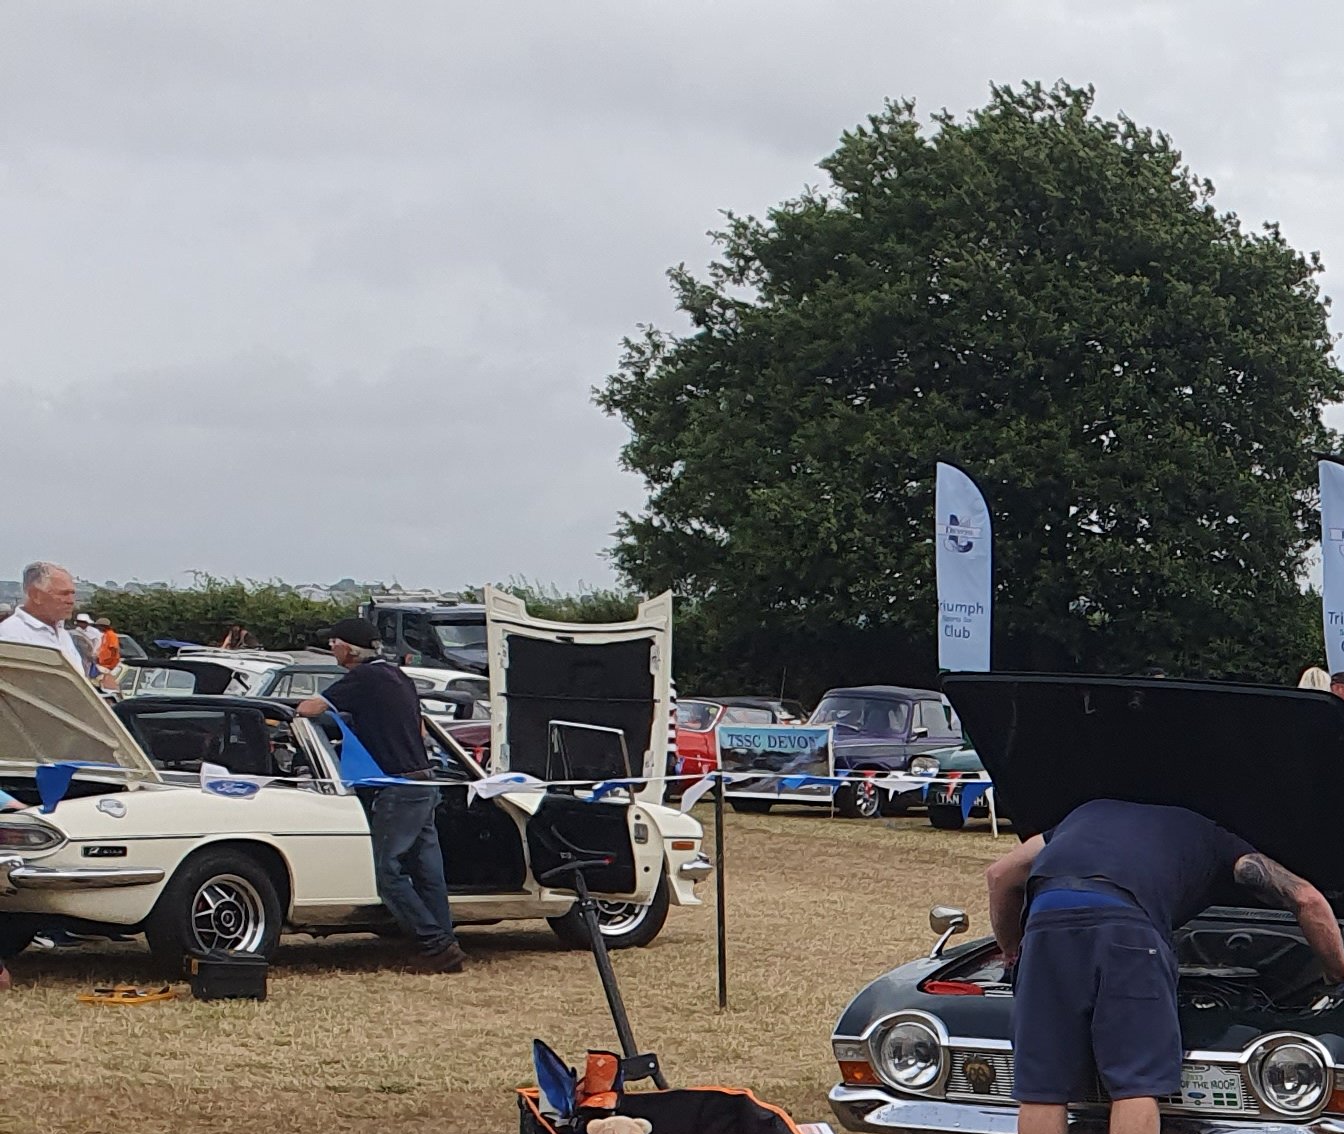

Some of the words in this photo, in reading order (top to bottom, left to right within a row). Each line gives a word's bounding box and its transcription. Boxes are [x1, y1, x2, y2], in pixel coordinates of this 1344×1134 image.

[944, 624, 971, 638] Club
[727, 733, 761, 748] TSSC
[767, 735, 818, 749] DEVON
[216, 782, 252, 795] Ford
[1191, 1081, 1209, 1089] THE
